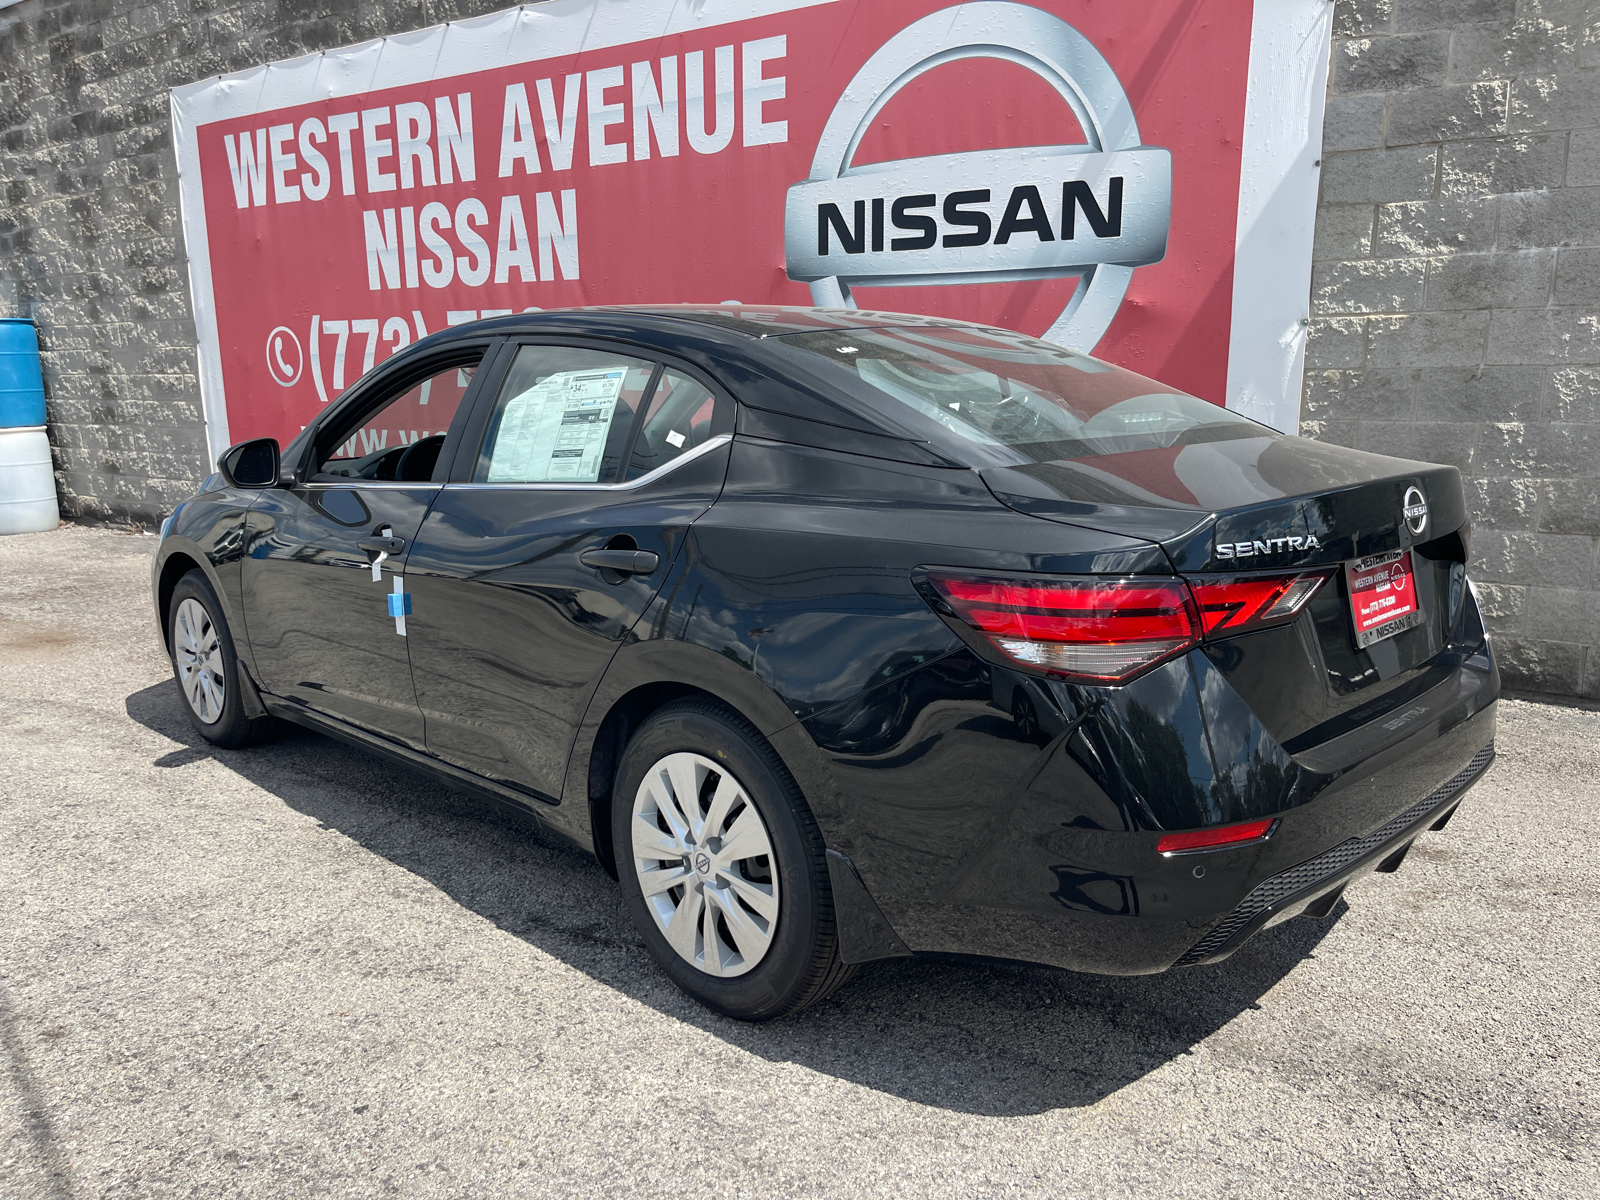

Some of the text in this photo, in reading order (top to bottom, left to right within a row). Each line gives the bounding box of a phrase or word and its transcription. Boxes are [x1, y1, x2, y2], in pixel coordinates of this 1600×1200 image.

[224, 34, 789, 209] WESTERN AVENUE
[817, 176, 1124, 256] NISSAN
[363, 188, 579, 291] NISSAN
[573, 384, 582, 393] 34
[1216, 534, 1321, 560] SENTRA
[1355, 570, 1389, 589] WESTERN AVENUE
[1375, 580, 1391, 593] NISSAN
[1390, 572, 1406, 582] NISSAN
[1376, 619, 1406, 639] NISSAN
